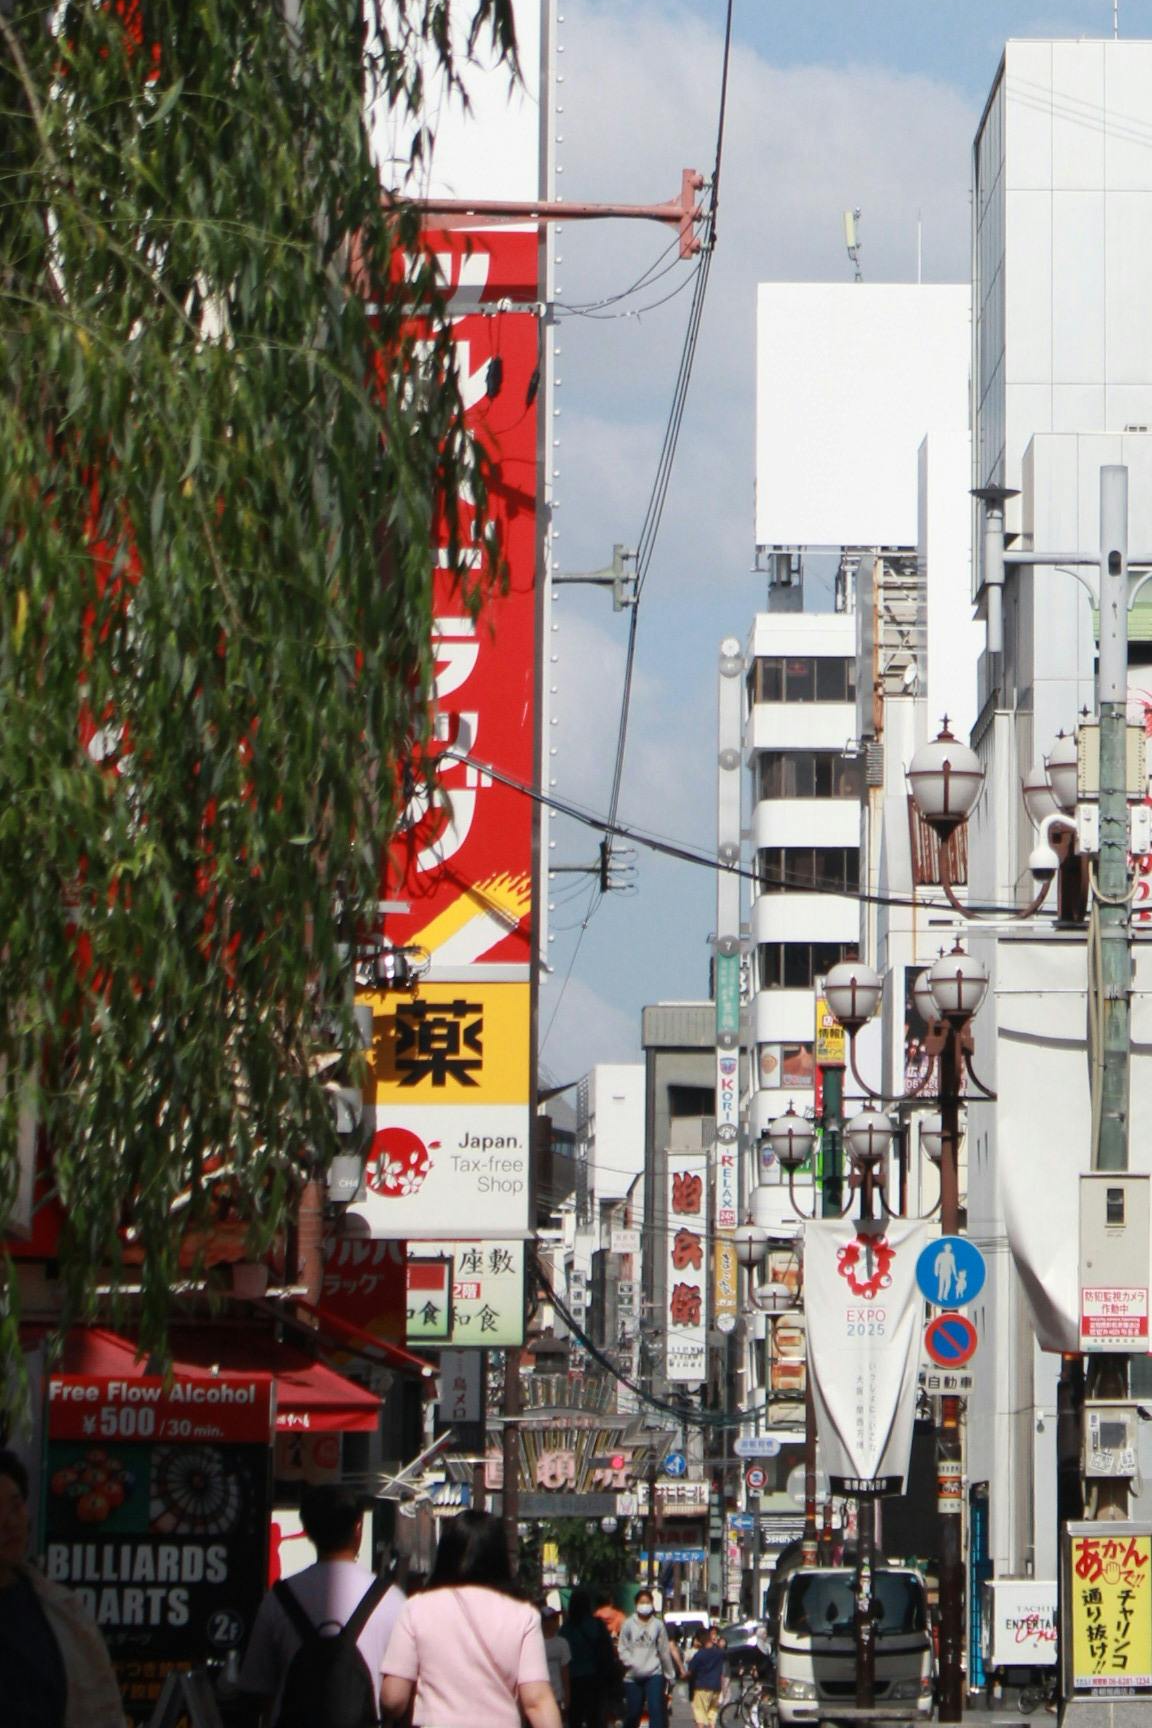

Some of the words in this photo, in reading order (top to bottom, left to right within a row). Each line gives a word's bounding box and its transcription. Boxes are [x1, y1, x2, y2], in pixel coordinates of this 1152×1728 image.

[395, 999, 484, 1087] 薬
[458, 1132, 523, 1152] Japan.
[450, 1155, 524, 1174] Tax-free
[477, 1175, 524, 1198] Shop
[458, 1247, 516, 1276] 座敷
[1085, 1291, 1145, 1302] 防犯監視カメラ
[847, 1310, 887, 1322] EXPO
[847, 1324, 885, 1336] 2025
[49, 1382, 99, 1403] Free
[107, 1382, 162, 1402] Flow
[169, 1383, 255, 1404] Alcohol
[928, 1375, 973, 1390] 自動車
[48, 1544, 228, 1583] BILLIARDS
[1075, 1537, 1149, 1584] あかん
[80, 1588, 190, 1627] DARTS
[214, 1614, 238, 1640] 2F
[1111, 1589, 1137, 1670] チャリンコ
